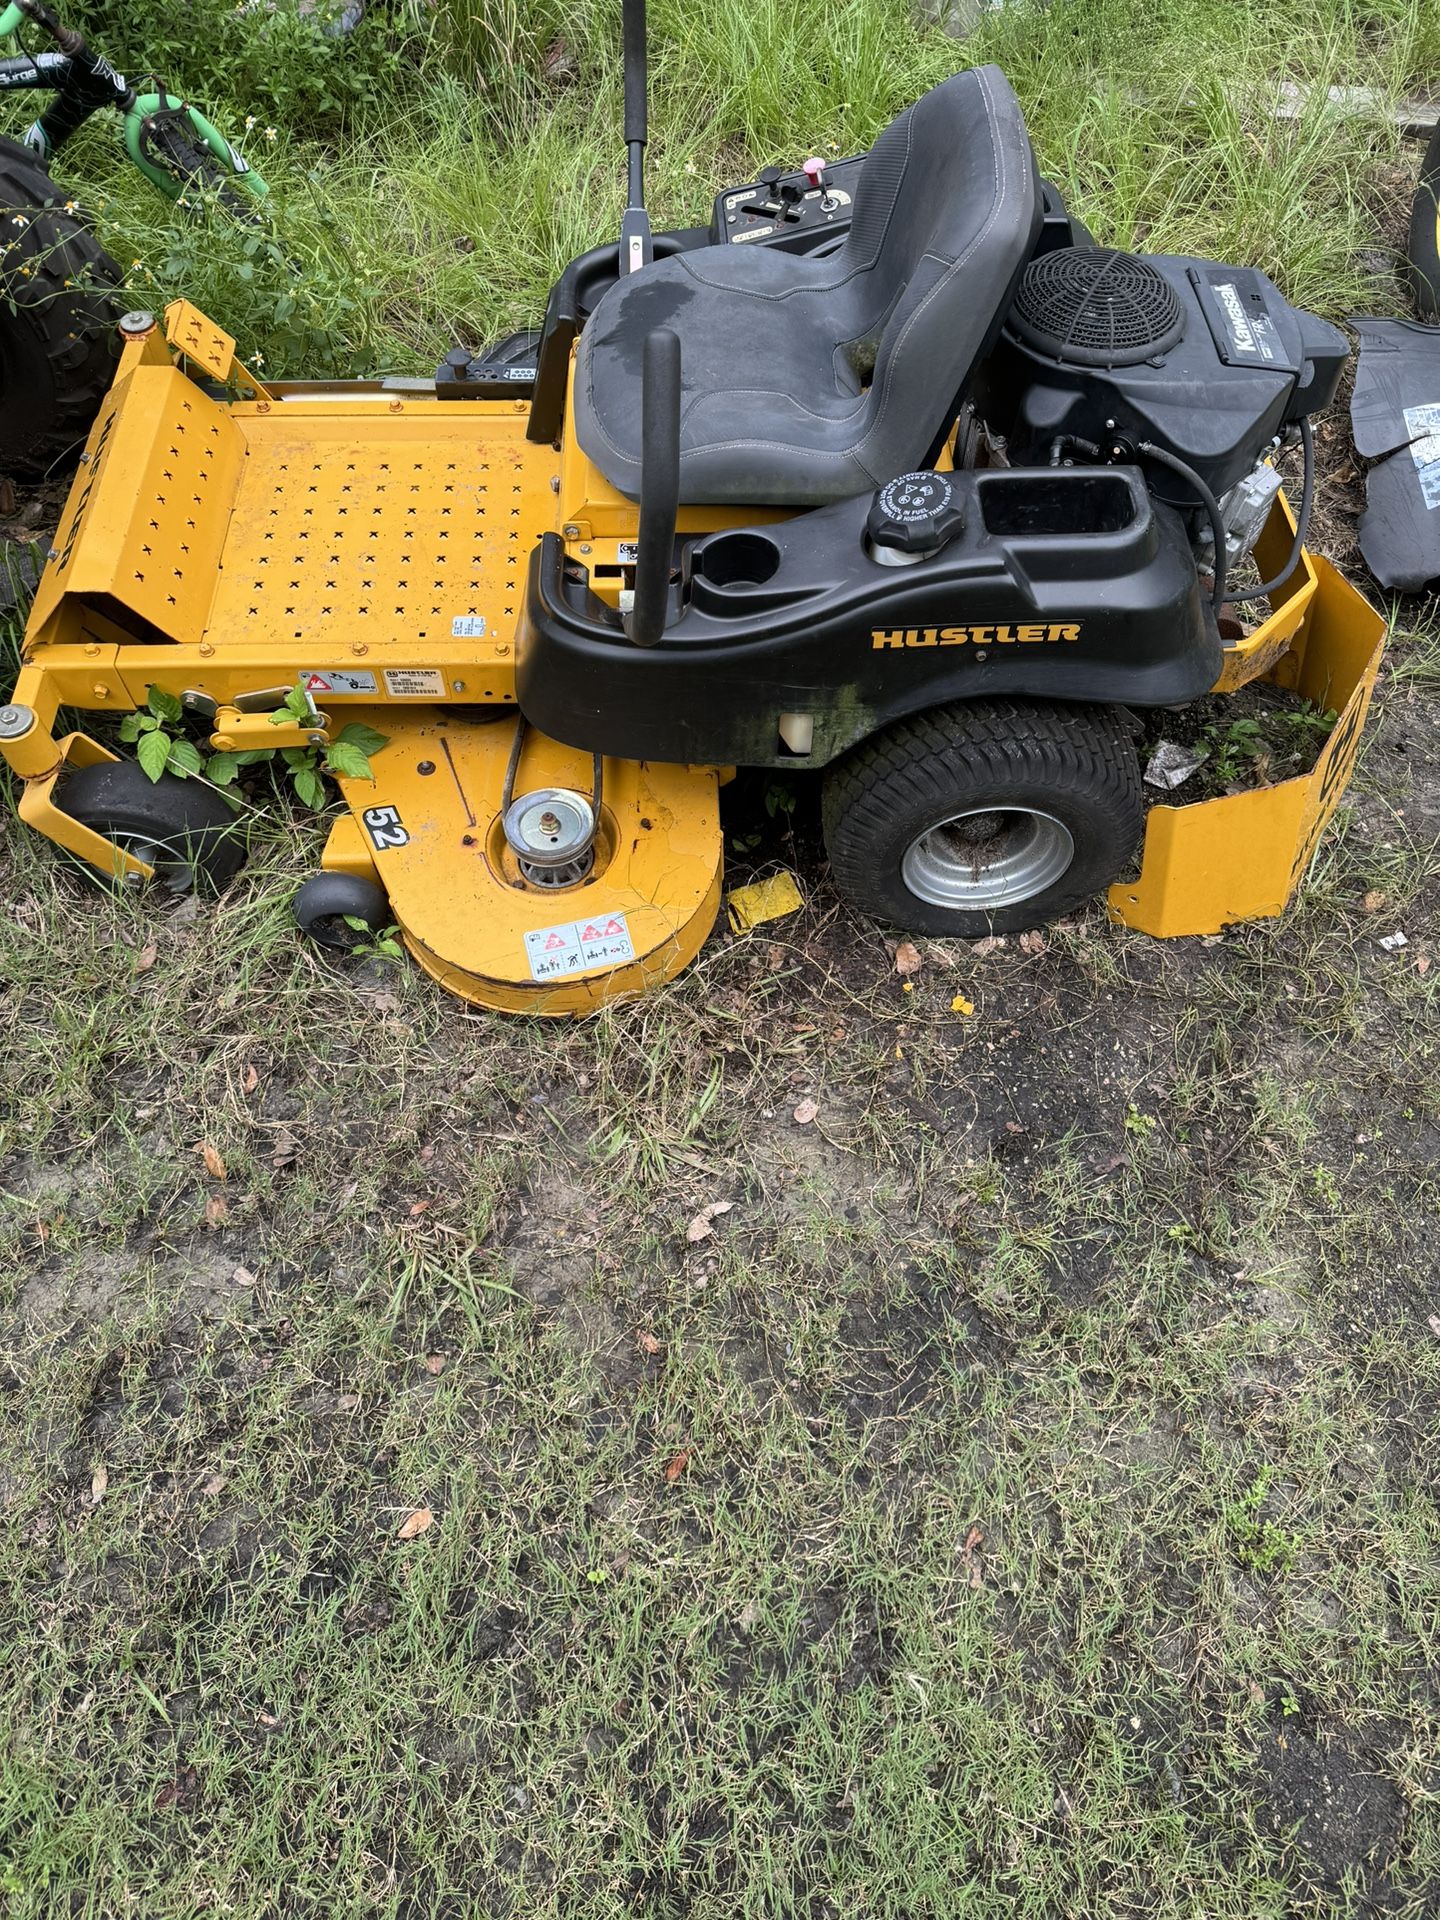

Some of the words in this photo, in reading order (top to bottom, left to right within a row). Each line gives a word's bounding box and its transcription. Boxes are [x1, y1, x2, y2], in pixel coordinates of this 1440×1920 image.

[903, 514, 928, 522] HIGHER
[928, 505, 944, 516] THAN
[911, 507, 929, 515] FUEL
[871, 623, 1081, 649] HUSTLER
[363, 805, 410, 850] 52
